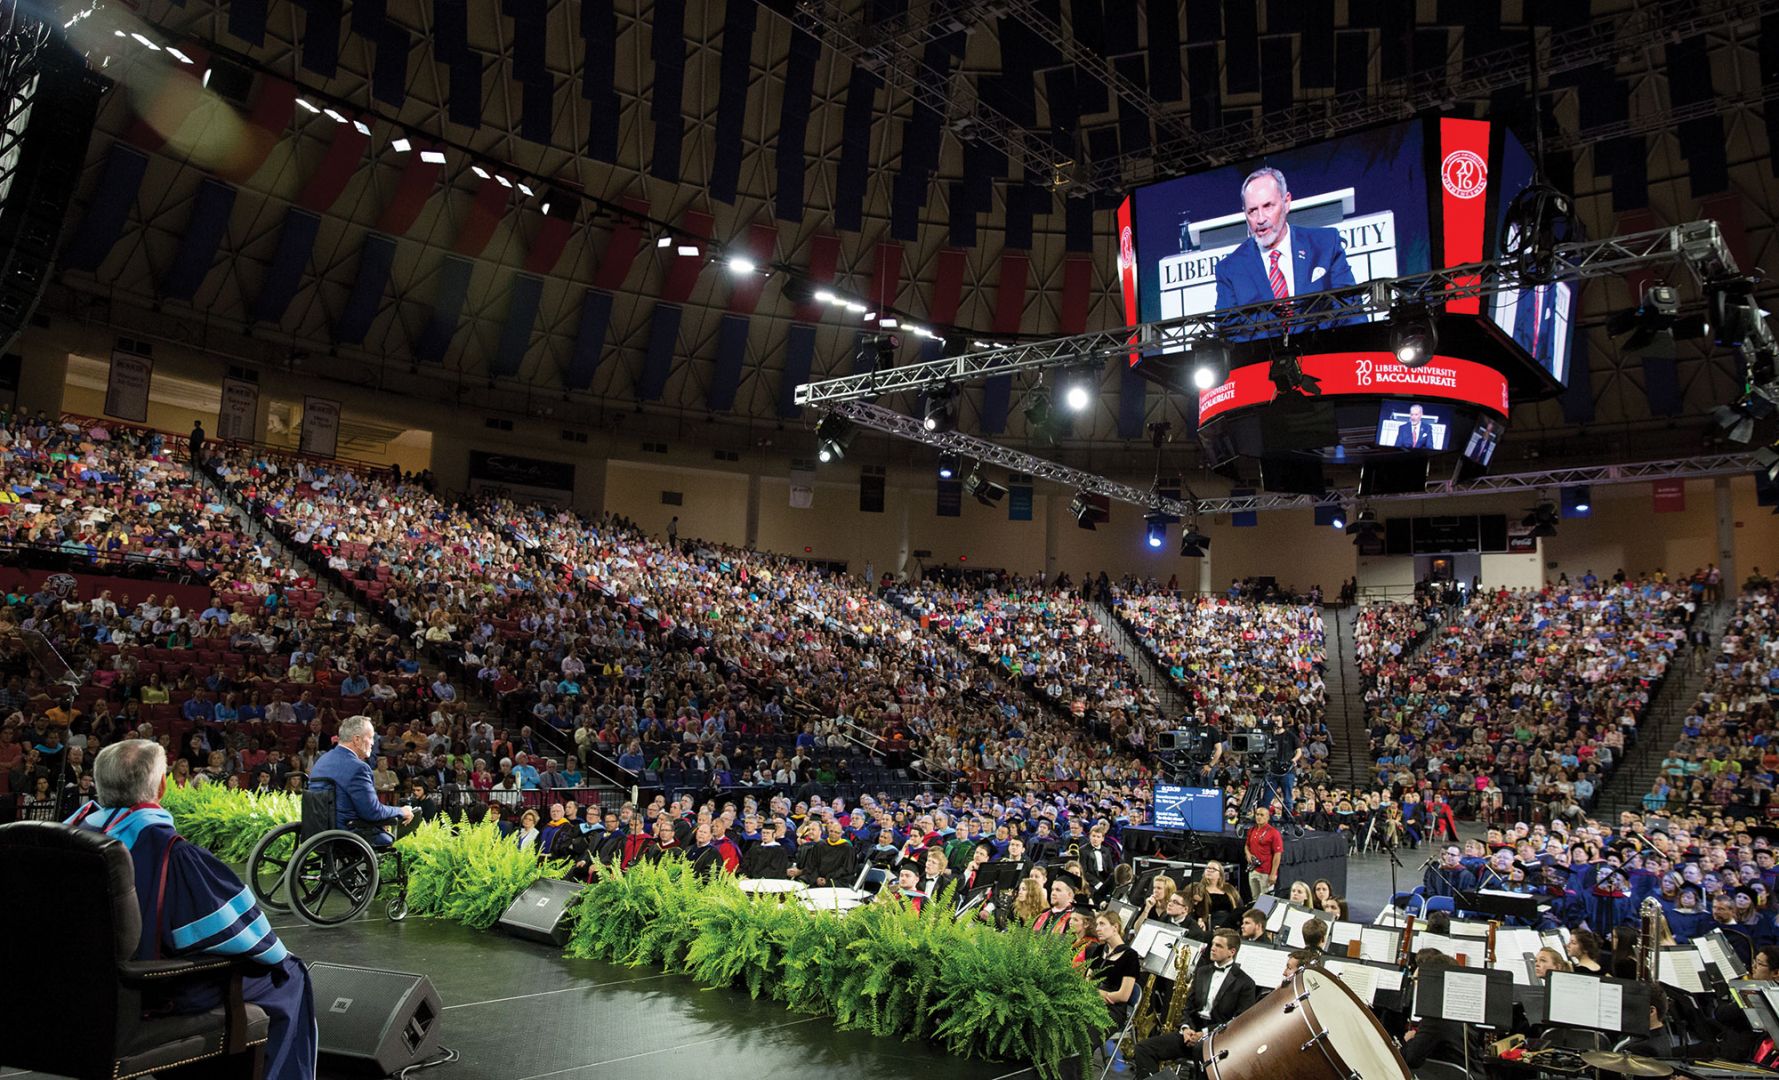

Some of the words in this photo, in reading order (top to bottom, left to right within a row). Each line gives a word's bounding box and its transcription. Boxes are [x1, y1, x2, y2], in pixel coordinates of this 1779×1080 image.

[1165, 254, 1227, 284] LIBER
[1355, 359, 1372, 373] 20
[1375, 364, 1408, 373] LIBERTY
[1411, 366, 1456, 378] UNIVERSITY
[1357, 372, 1372, 386] 16
[1376, 373, 1456, 387] BACCALAUREATE
